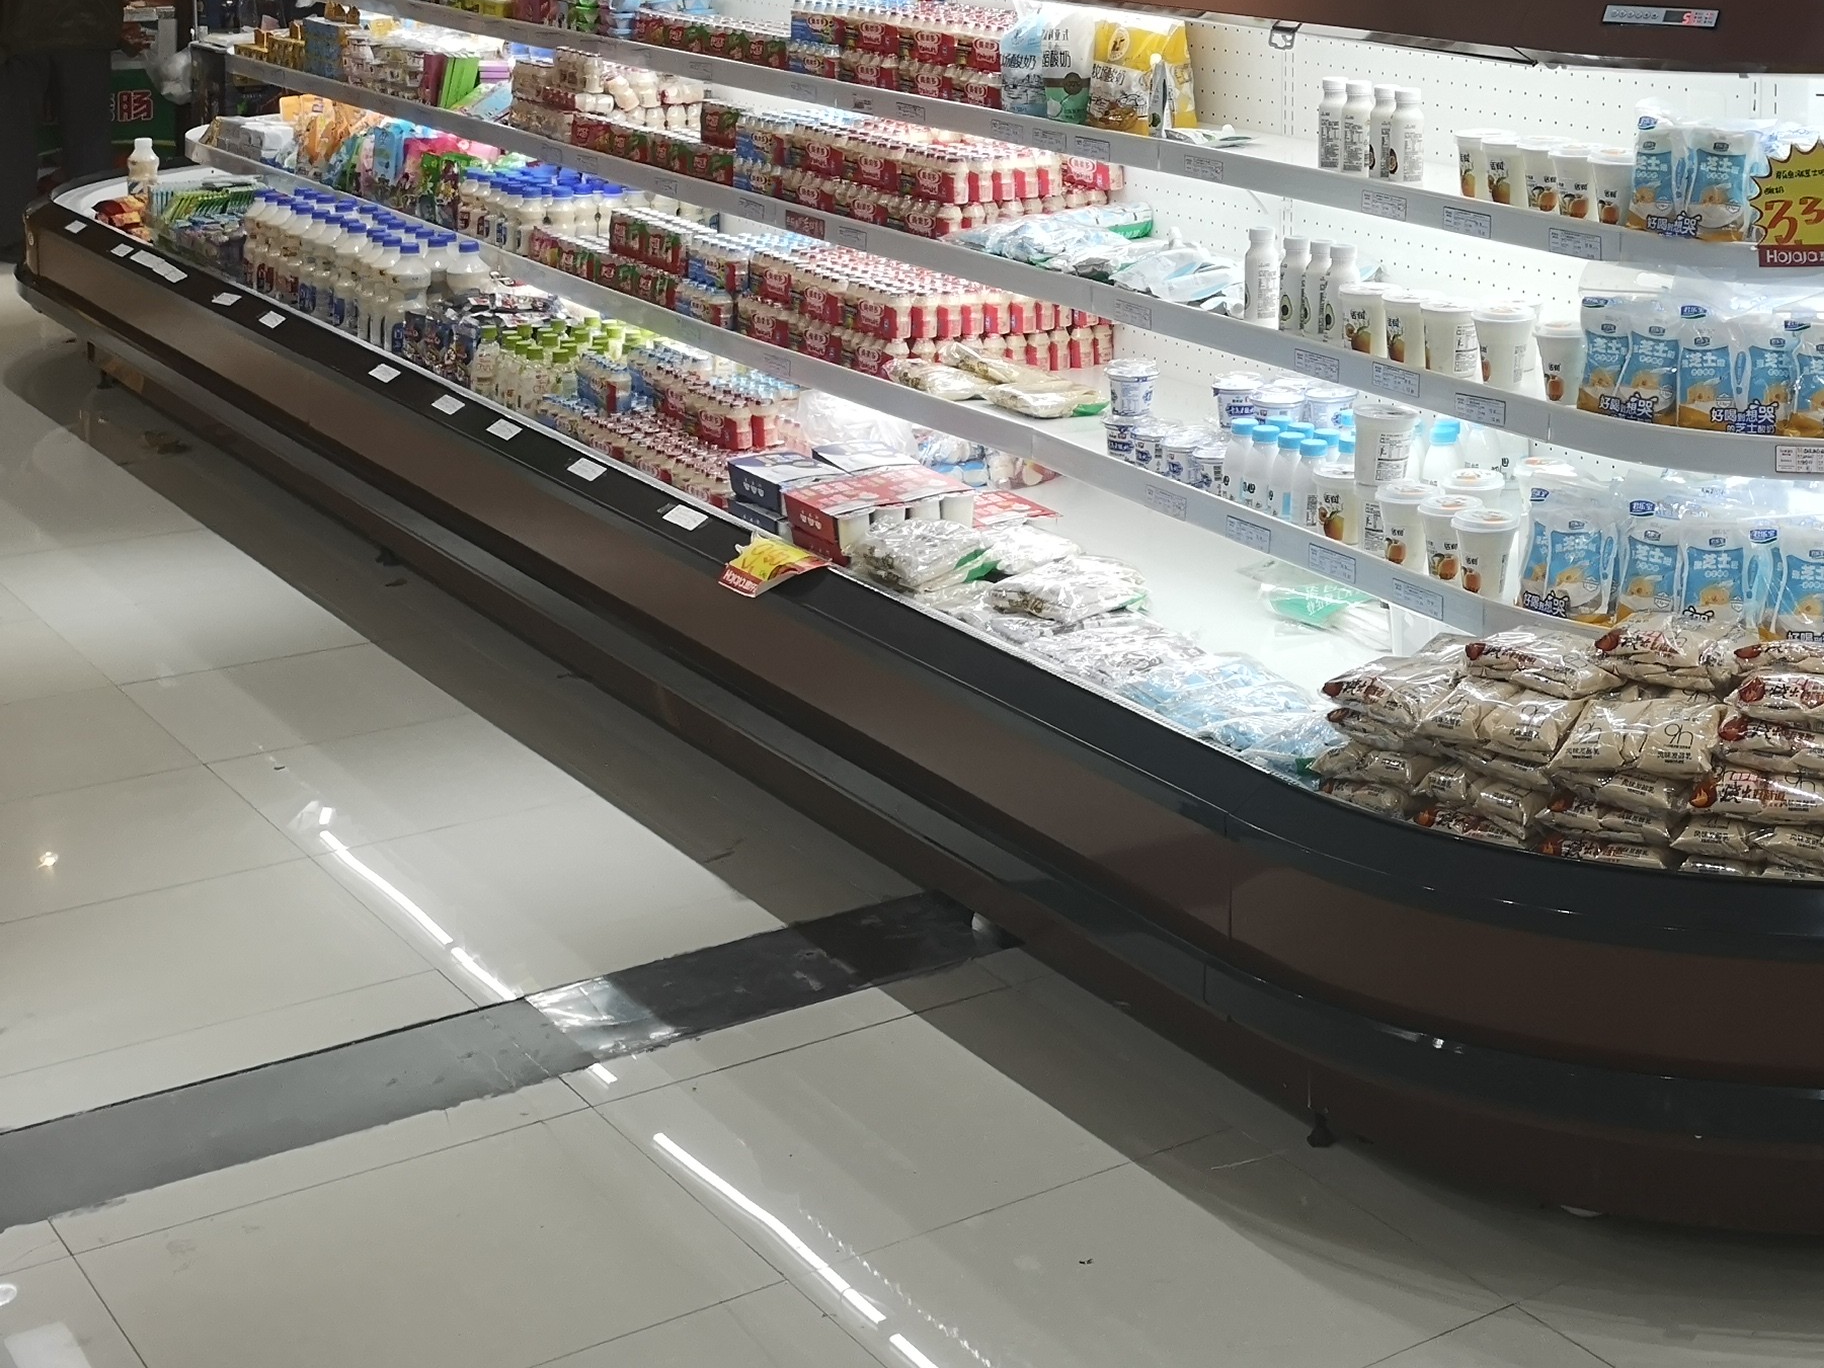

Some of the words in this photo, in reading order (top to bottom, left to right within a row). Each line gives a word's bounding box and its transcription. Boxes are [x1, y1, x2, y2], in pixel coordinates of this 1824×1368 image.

[1000, 53, 1036, 70] 场酸奶
[1092, 64, 1126, 85] 牧场酸奶
[1711, 405, 1776, 424] 好喝到想哭
